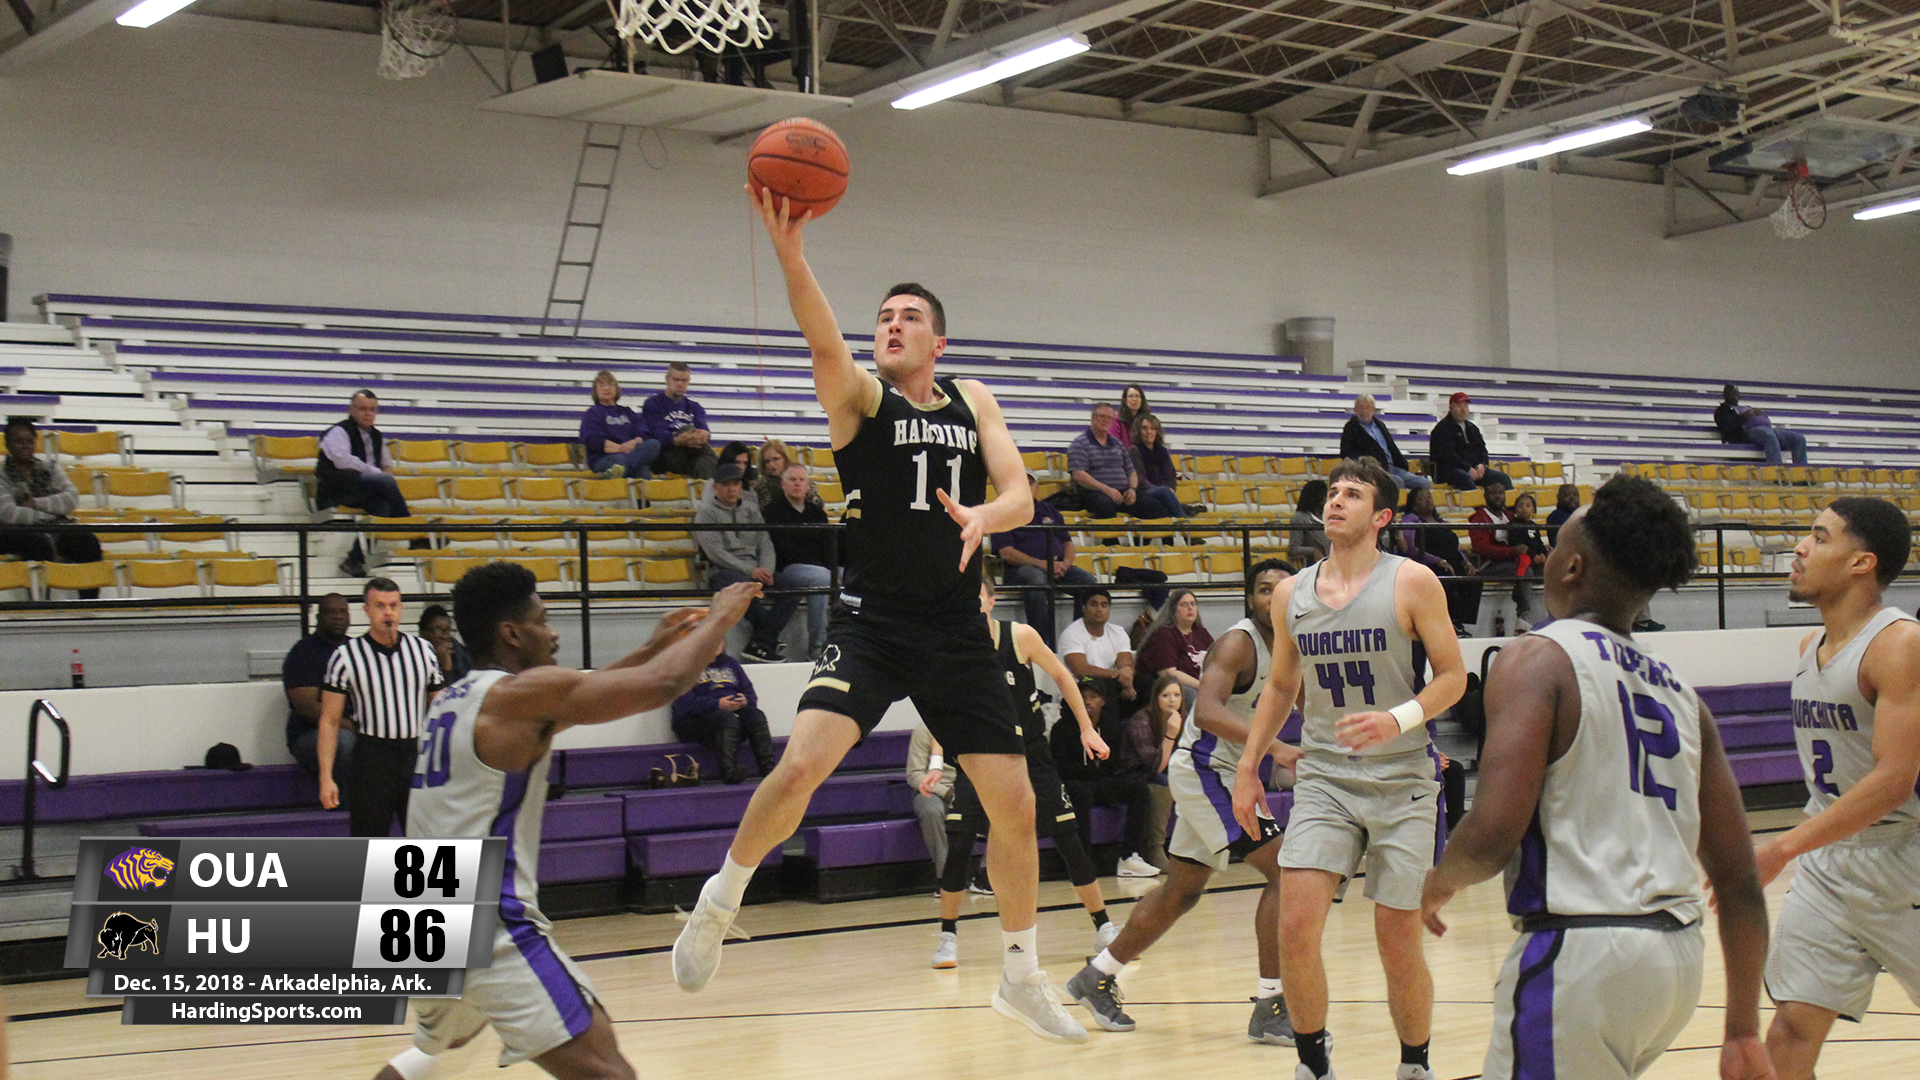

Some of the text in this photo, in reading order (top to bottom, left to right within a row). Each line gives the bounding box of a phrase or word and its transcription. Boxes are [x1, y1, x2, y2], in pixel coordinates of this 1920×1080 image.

[894, 418, 977, 454] HARDING
[910, 450, 962, 512] 11
[1297, 628, 1387, 657] OUACHITA
[1314, 660, 1376, 708] 44
[1791, 699, 1858, 731] UACHITA
[1617, 680, 1681, 811] 12
[1811, 739, 1841, 797] 2
